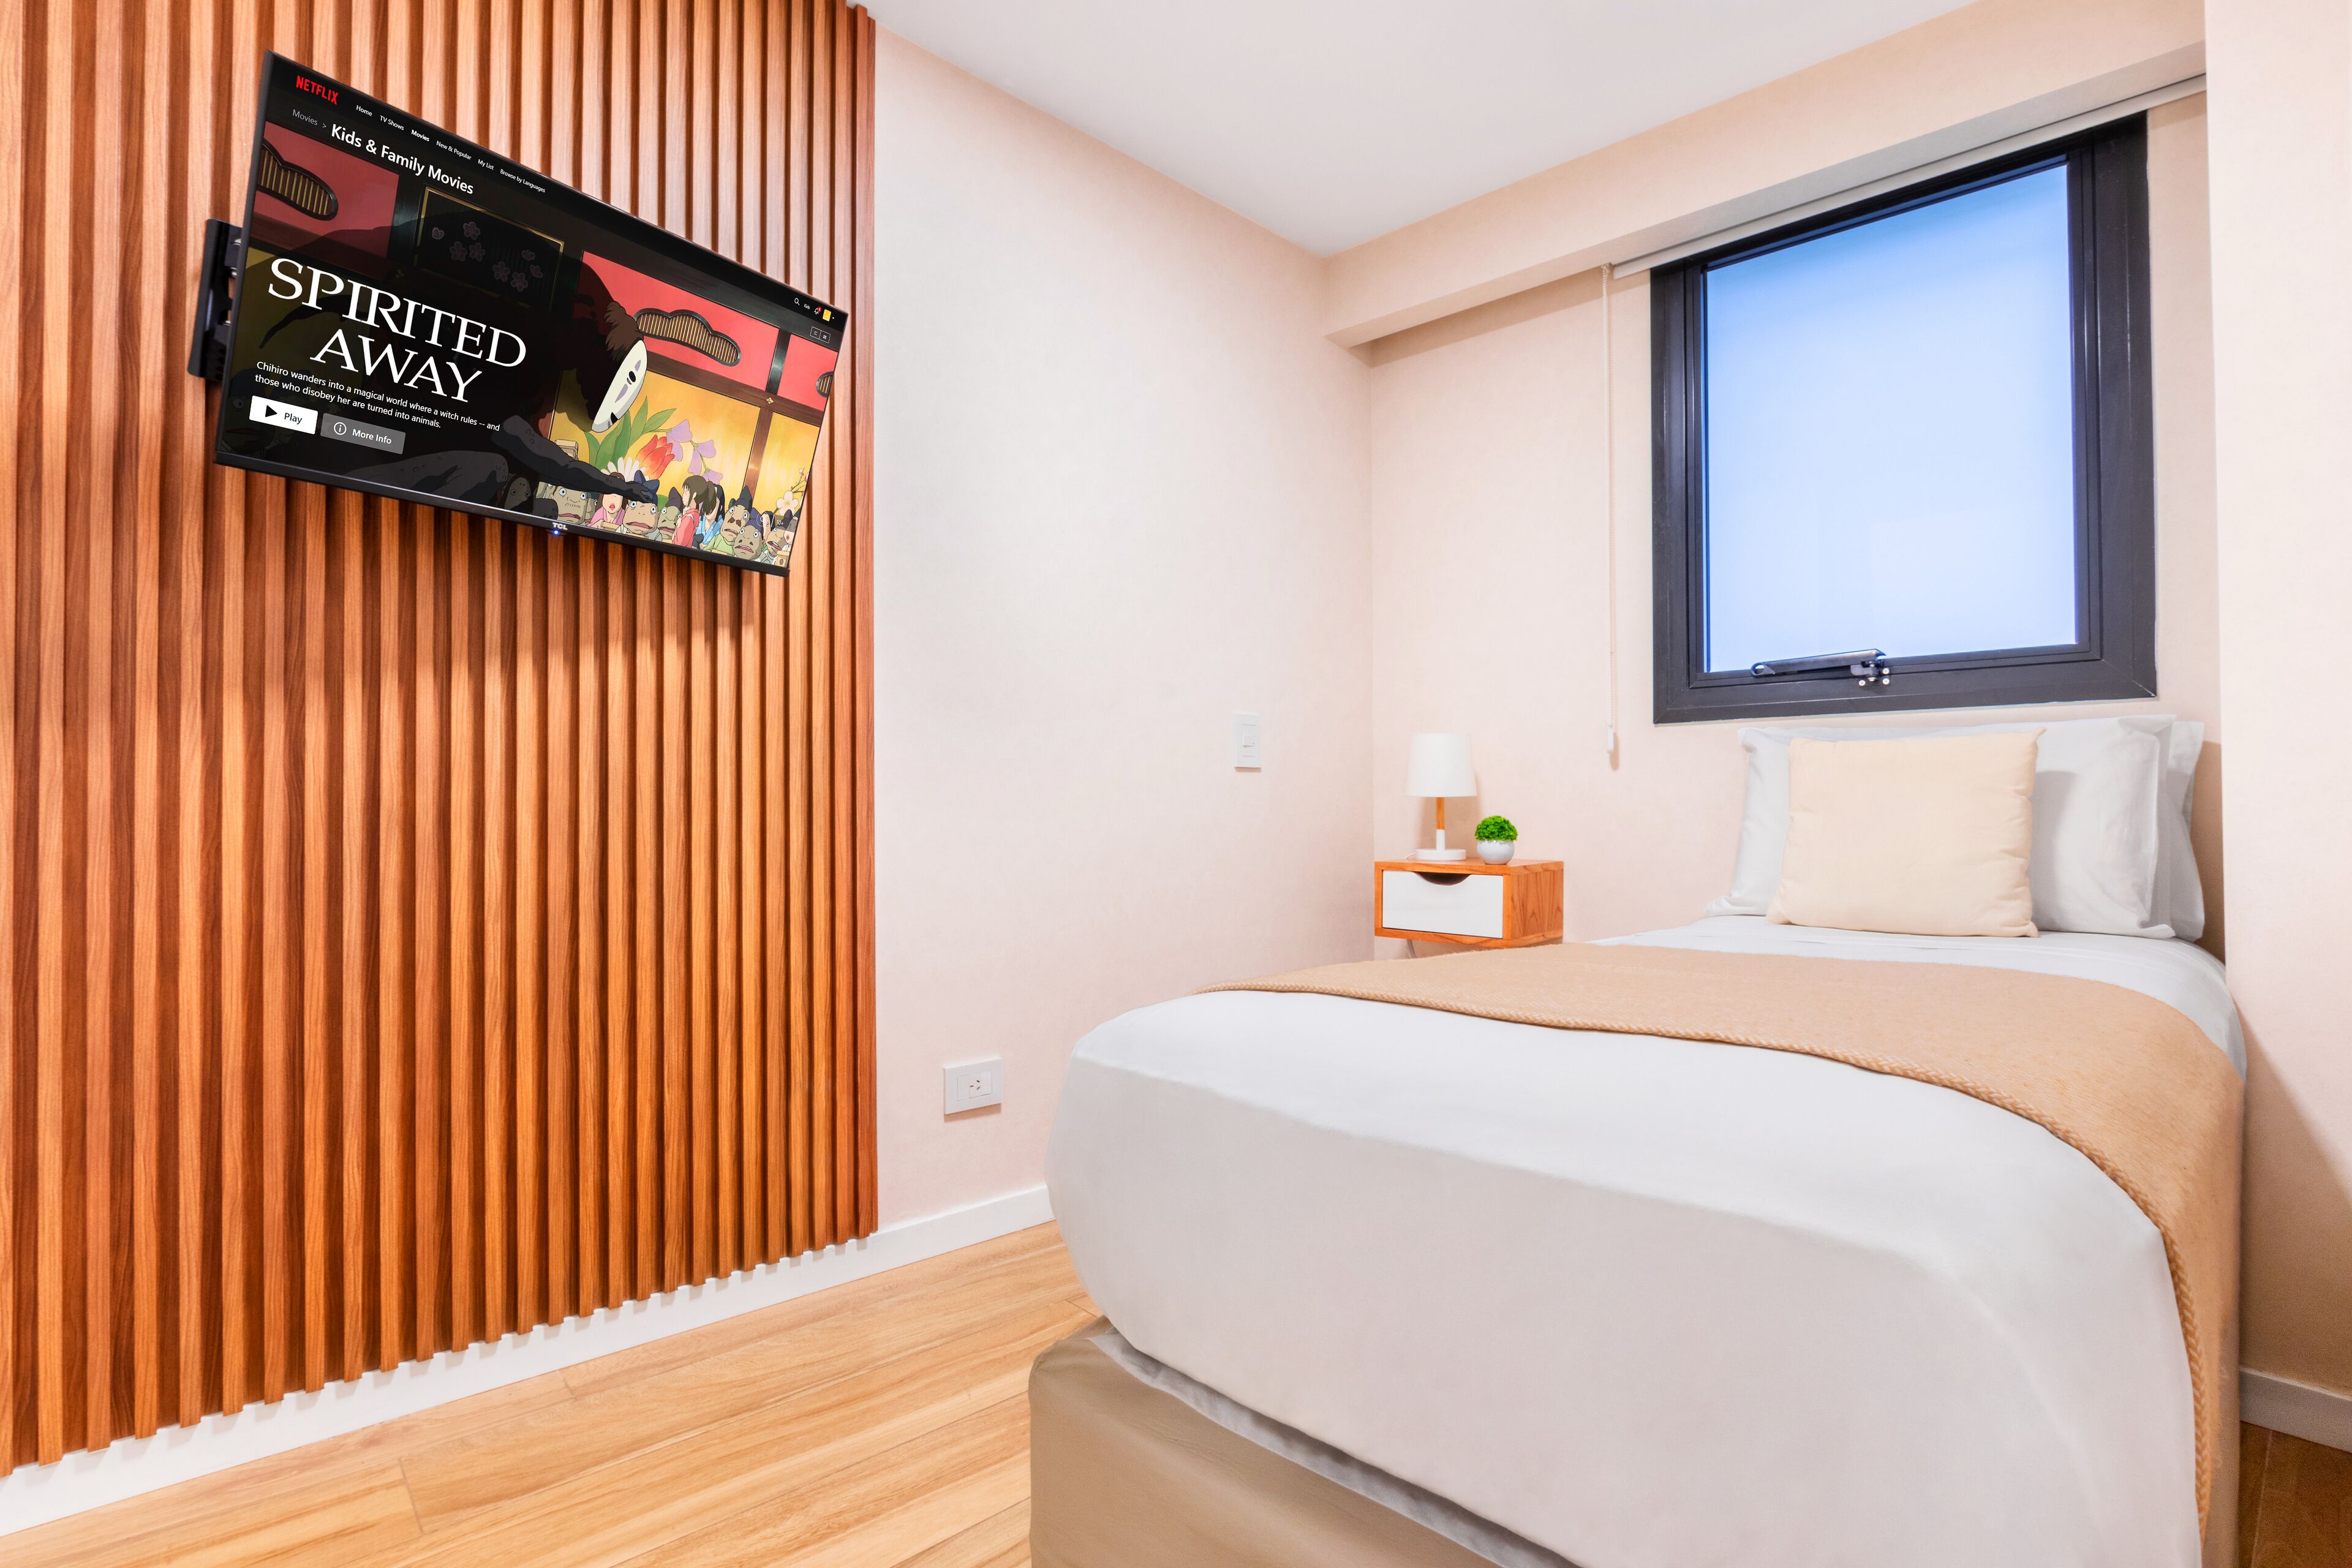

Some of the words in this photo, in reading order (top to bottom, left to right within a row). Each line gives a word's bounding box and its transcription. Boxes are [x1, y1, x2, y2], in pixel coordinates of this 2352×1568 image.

[296, 75, 339, 105] NETFLIX
[356, 105, 373, 116] Home
[380, 115, 388, 123] TV
[388, 119, 405, 130] Shows
[411, 129, 430, 142] Movies
[292, 109, 318, 126] Movies
[331, 123, 362, 148] Kids
[366, 139, 377, 155] &
[381, 145, 425, 176] Family
[428, 165, 474, 194] Movies
[436, 140, 448, 150] New
[454, 148, 472, 160] Popular
[478, 159, 485, 167] My
[486, 162, 494, 171] List
[500, 168, 516, 180] Browse
[523, 179, 546, 194] Languages
[268, 258, 527, 368] SPIRITED
[310, 328, 483, 403] AWAY
[255, 374, 280, 387] those
[282, 382, 301, 393] who
[302, 386, 336, 403] disobey
[337, 394, 351, 405] her
[352, 401, 366, 409] are
[368, 402, 393, 416] turned
[394, 409, 410, 420] into
[411, 415, 441, 428] animals.
[257, 361, 288, 376] Chihiro
[290, 371, 326, 386] wanders
[328, 379, 345, 391] into
[353, 388, 385, 401] magical
[386, 397, 408, 407] world
[409, 402, 432, 413] where
[440, 410, 459, 421] witch
[460, 415, 478, 426] rules
[486, 423, 500, 432] and
[284, 412, 303, 424] Play
[352, 429, 374, 440] More
[375, 434, 392, 445] Info
